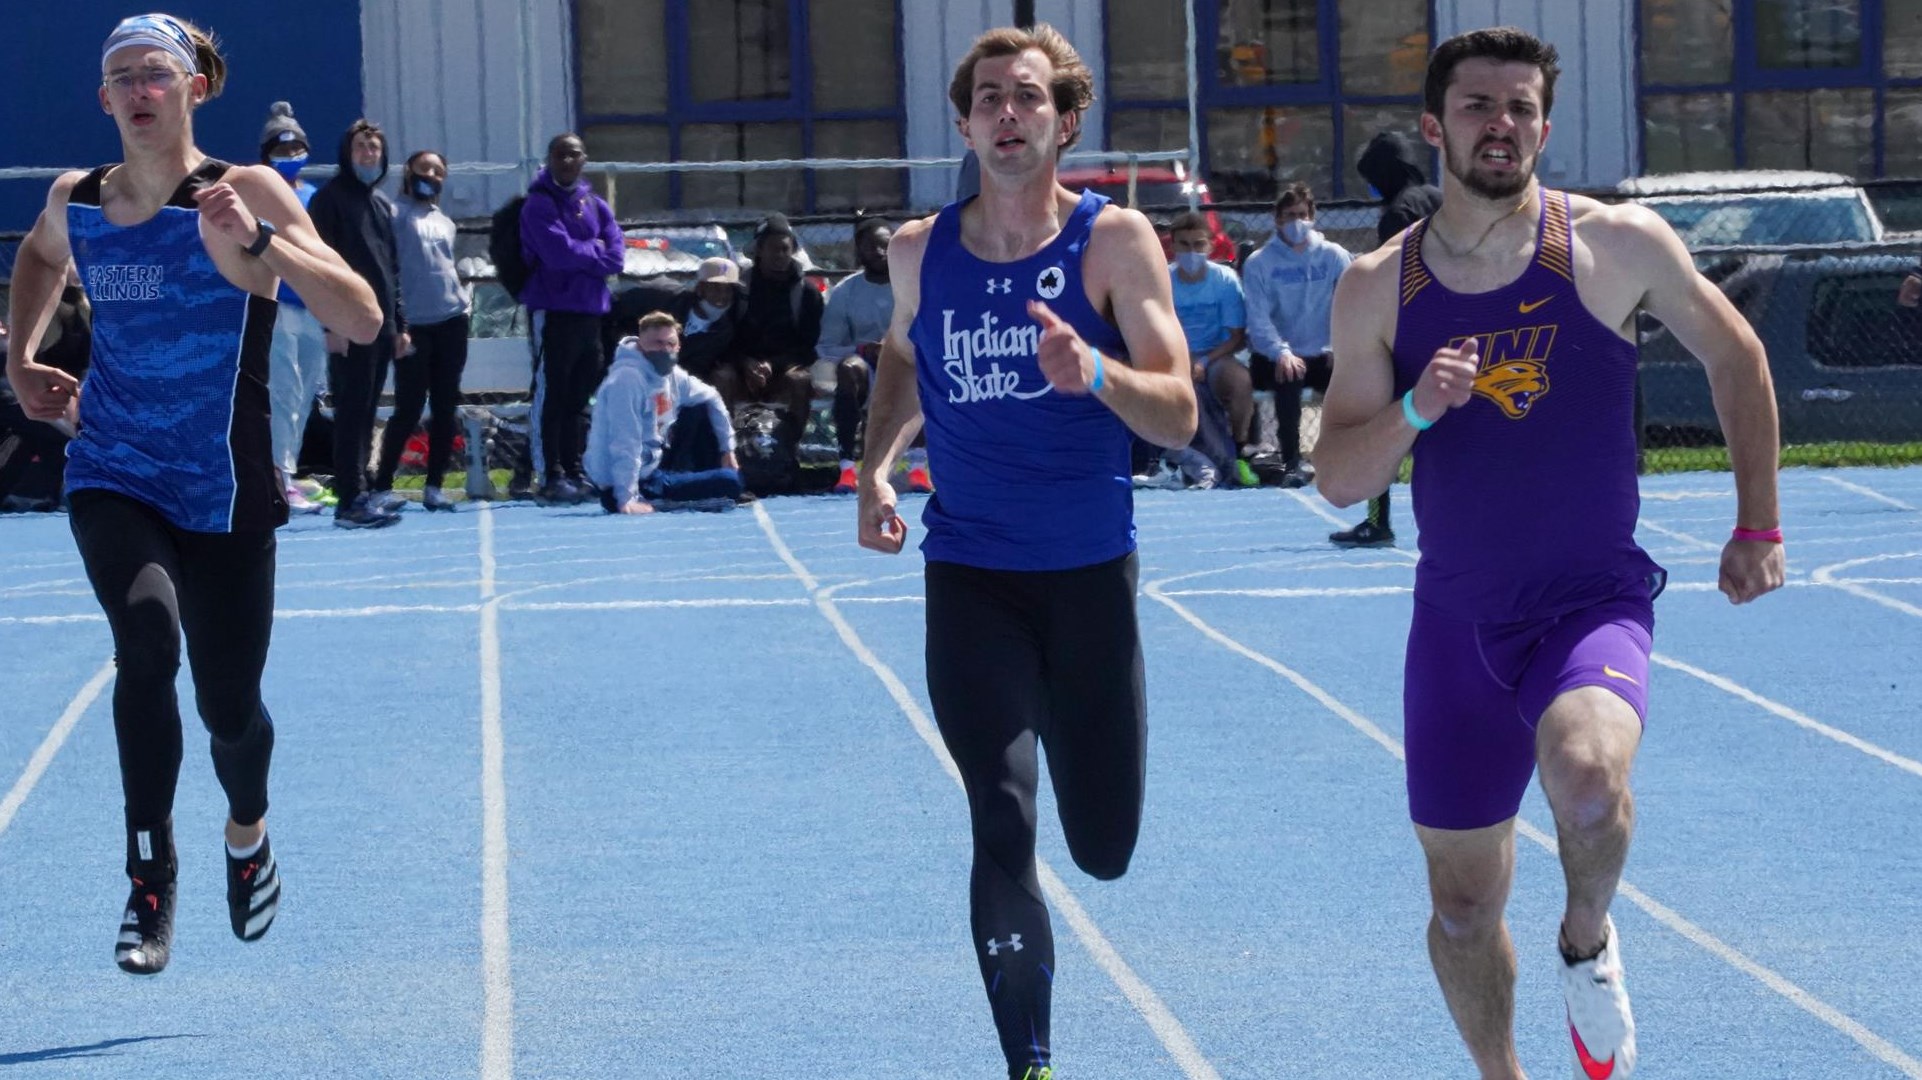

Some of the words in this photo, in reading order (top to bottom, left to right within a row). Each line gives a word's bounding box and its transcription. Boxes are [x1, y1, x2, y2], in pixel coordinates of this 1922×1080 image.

[88, 264, 164, 284] EASTERN
[942, 309, 1039, 364] Indian
[943, 359, 1055, 403] State
